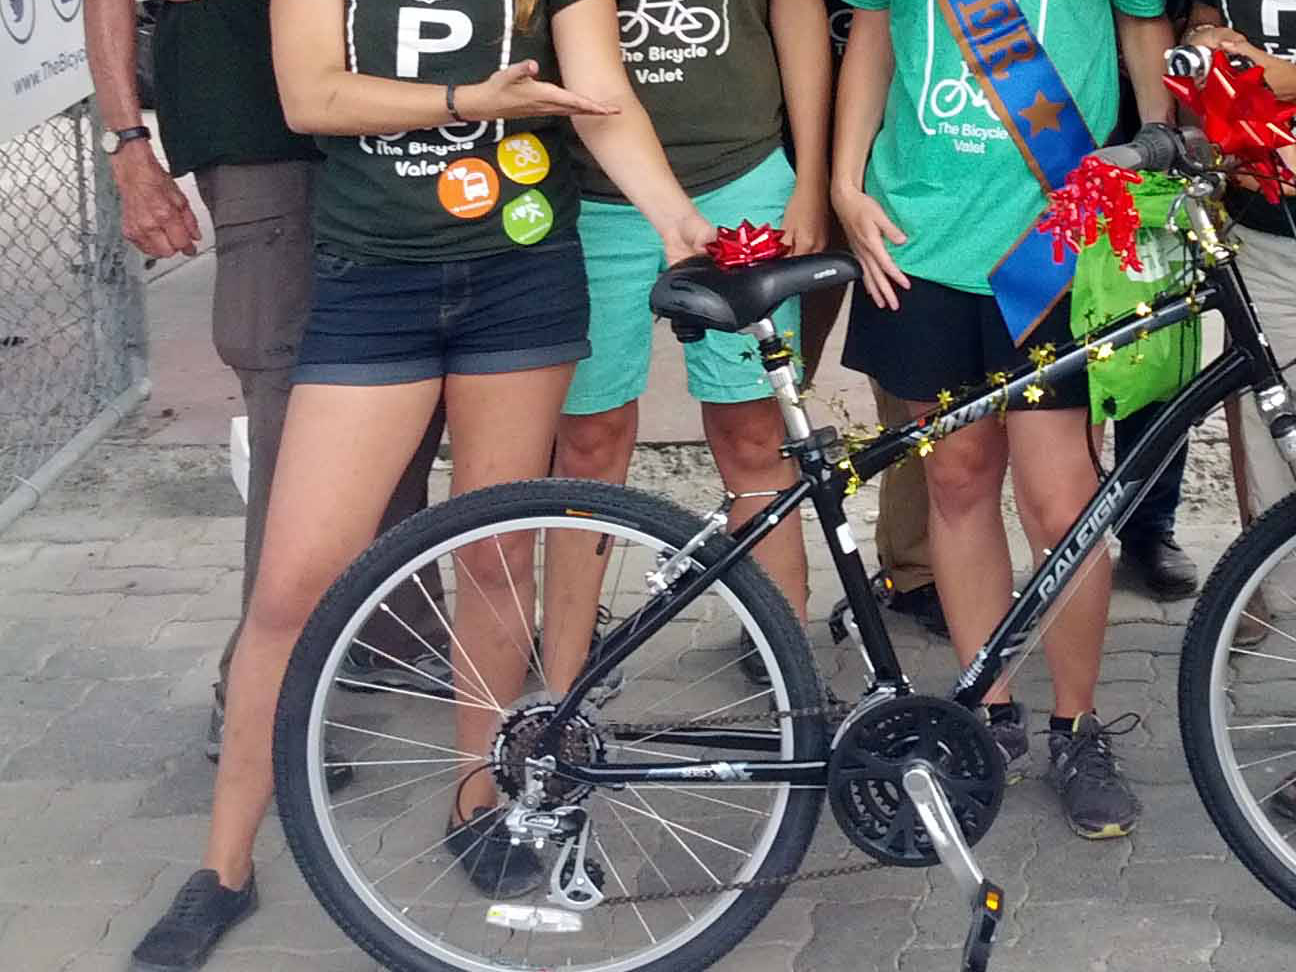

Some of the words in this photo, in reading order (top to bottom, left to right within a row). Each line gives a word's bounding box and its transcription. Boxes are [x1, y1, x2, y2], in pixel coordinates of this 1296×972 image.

[396, 6, 474, 78] P
[648, 44, 708, 64] Bicycle
[635, 67, 685, 85] Valet
[937, 122, 959, 137] The
[961, 122, 1009, 141] Bicycle
[376, 140, 404, 156] The
[407, 140, 475, 157] Bicycle
[953, 139, 986, 155] Valet
[395, 159, 448, 178] Valet
[1037, 479, 1126, 605] RALEIGH
